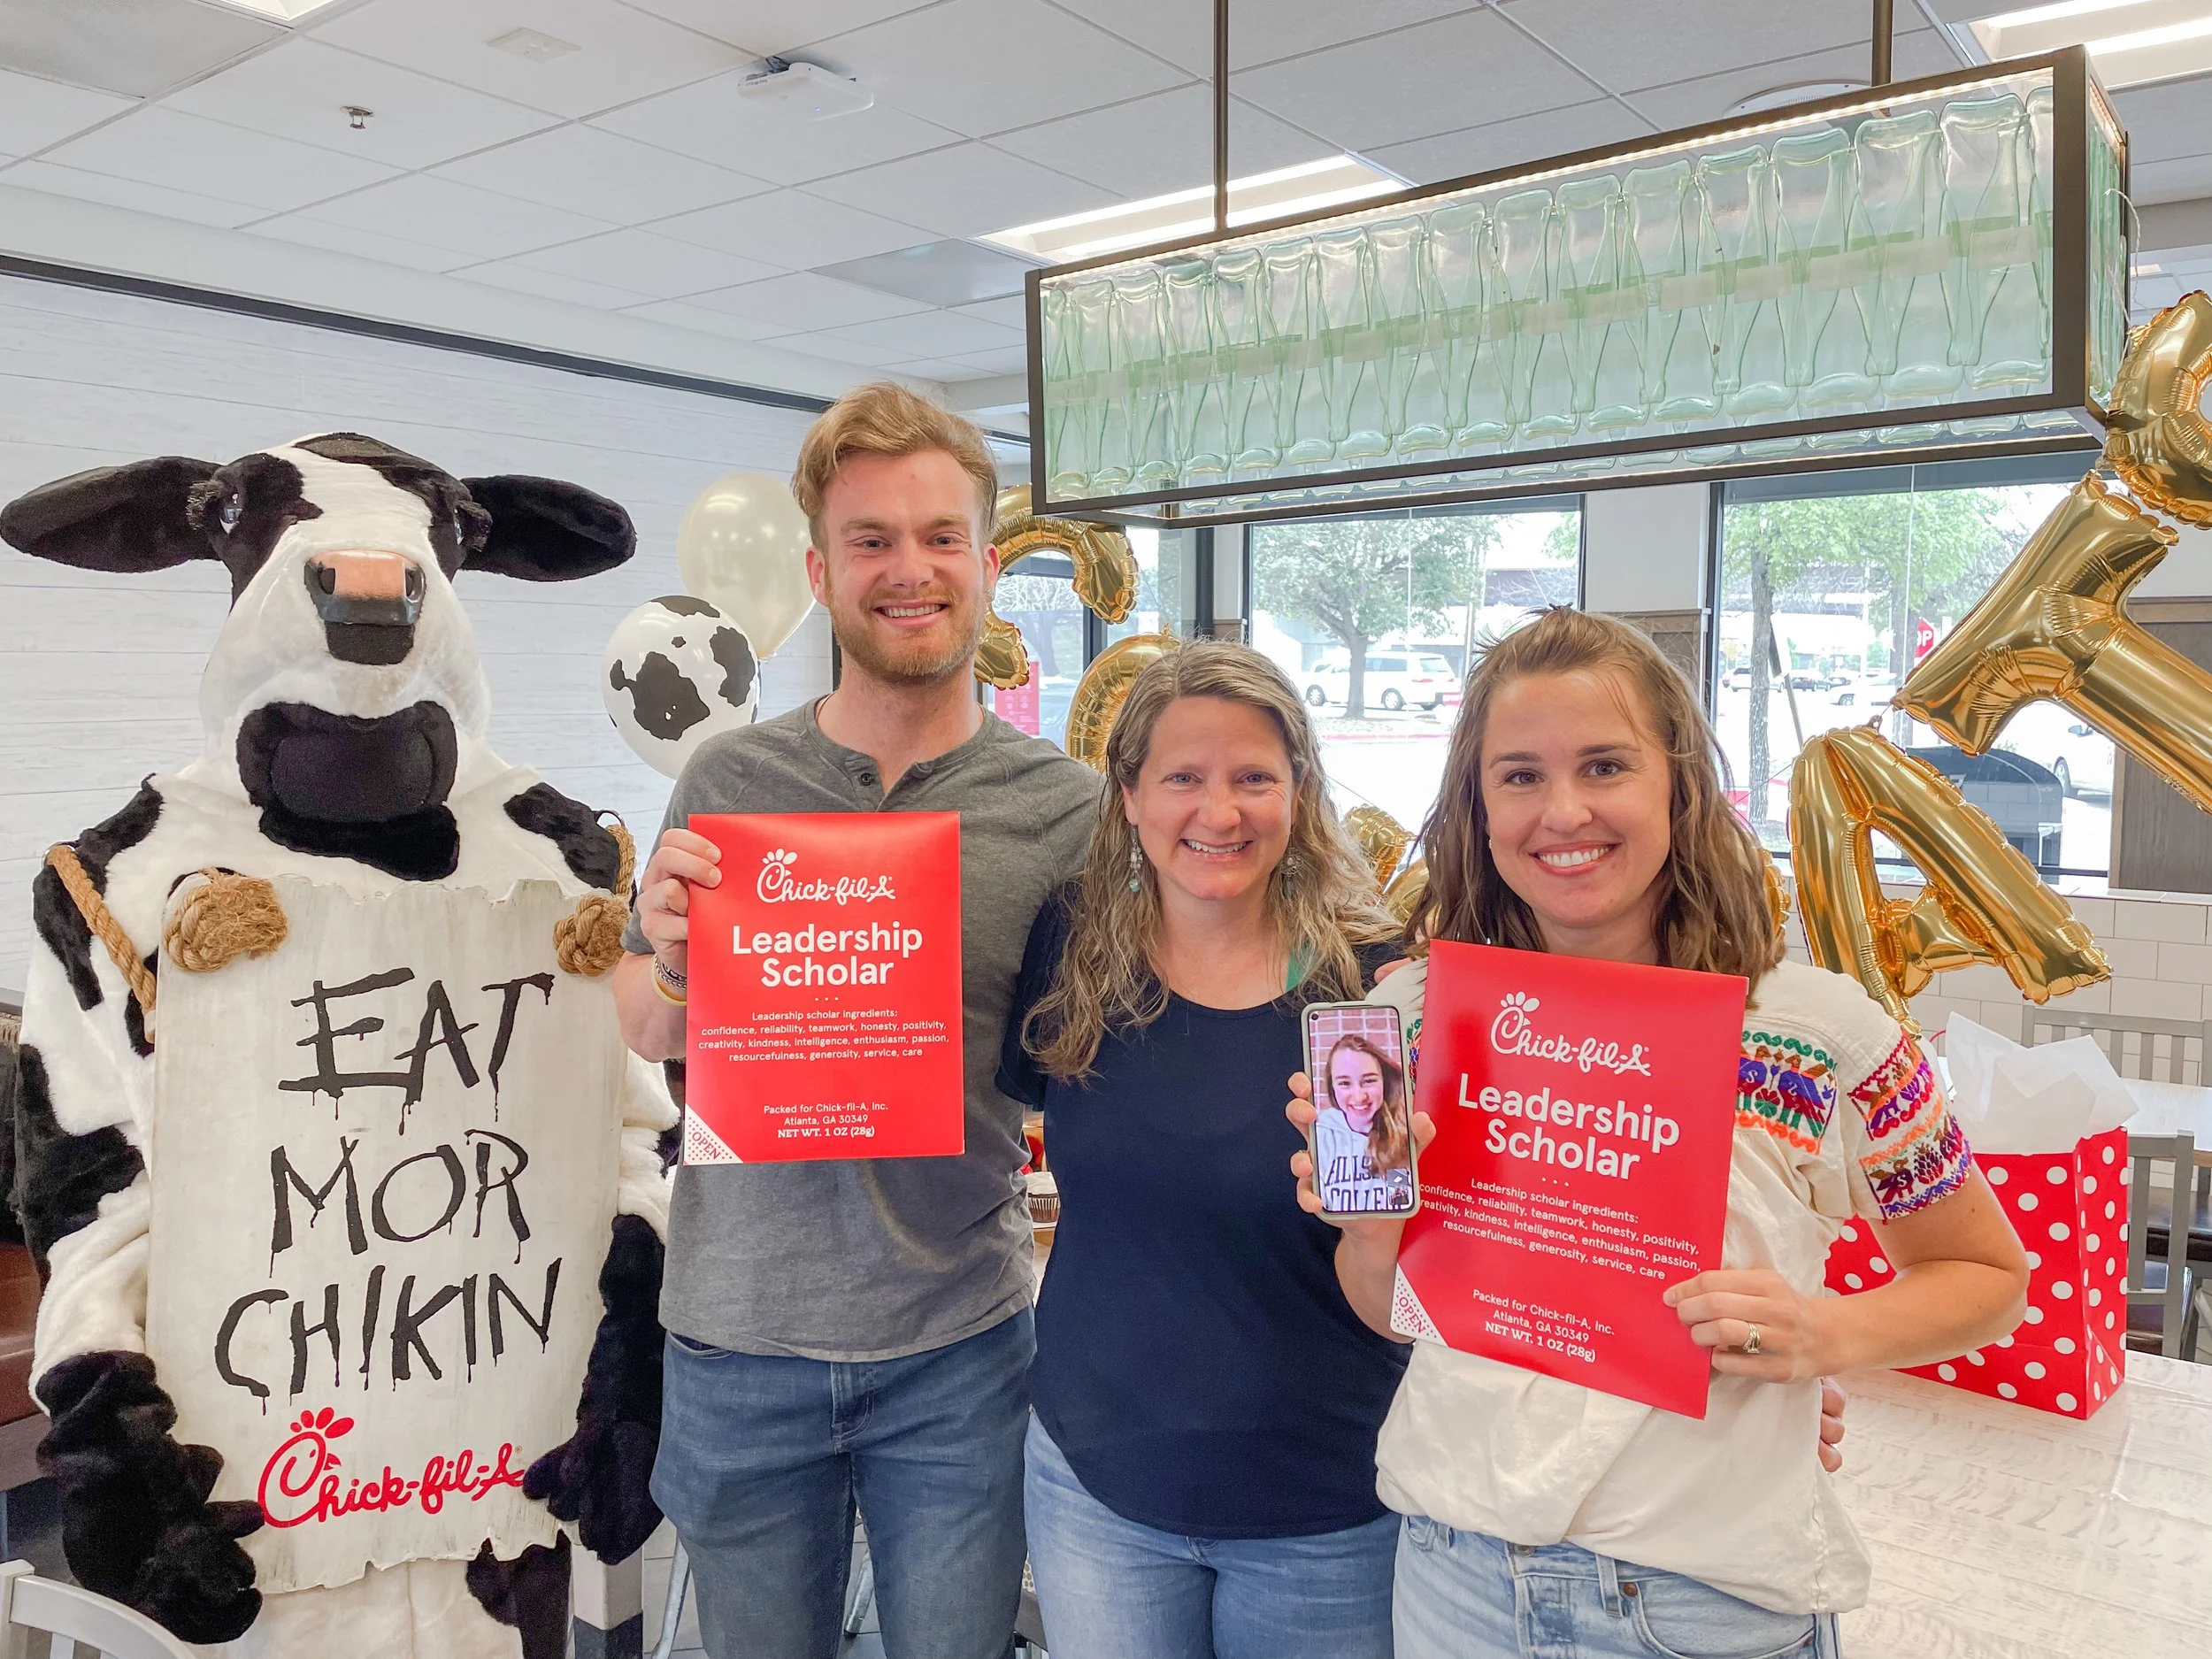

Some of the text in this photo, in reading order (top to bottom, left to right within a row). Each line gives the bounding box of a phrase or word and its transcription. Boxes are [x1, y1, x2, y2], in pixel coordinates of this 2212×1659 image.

[733, 920, 923, 958] Leadership
[761, 955, 895, 987] Scholar
[701, 1020, 947, 1036] confidence, reliability, teamwork, honesty, positivity,
[752, 1009, 898, 1022] Leadership scholar ingredients:
[278, 967, 556, 1136] EAT
[698, 1033, 949, 1050] creativity, kindness, intelligence, enthusiasm, passion,
[728, 1048, 923, 1062] resourcefulness, generosity, service, care
[764, 1105, 797, 1114] Packed
[799, 1104, 813, 1113] for
[816, 1103, 869, 1113] Chick-fil-A,
[784, 1114, 869, 1126] Atlanta, GA 30349
[1458, 1072, 1680, 1154] Leadership
[692, 1131, 721, 1160] OPEN
[778, 1125, 875, 1139] NET WT. 1 OZ (28g)
[1485, 1118, 1640, 1180] Scholar
[268, 1128, 532, 1279] MOR
[1419, 1183, 1700, 1256] confidence, reliability, teamwork, honesty, positivity,
[1471, 1178, 1639, 1224] Leadership scholar ingredients:
[1419, 1197, 1701, 1272] reativity, kindness, intelligence, enthusiasm, passion,
[1442, 1219, 1666, 1281] resourcefulness, generosity, service, care
[1399, 1296, 1426, 1334] OPEN
[1472, 1289, 1616, 1336] Packed for Chick-fil-A, Inc.
[1493, 1310, 1590, 1344] Atlanta, GA 30349
[214, 1257, 563, 1416] CHIKIN
[1485, 1321, 1596, 1364] NET WT. 1 OZ (28g)
